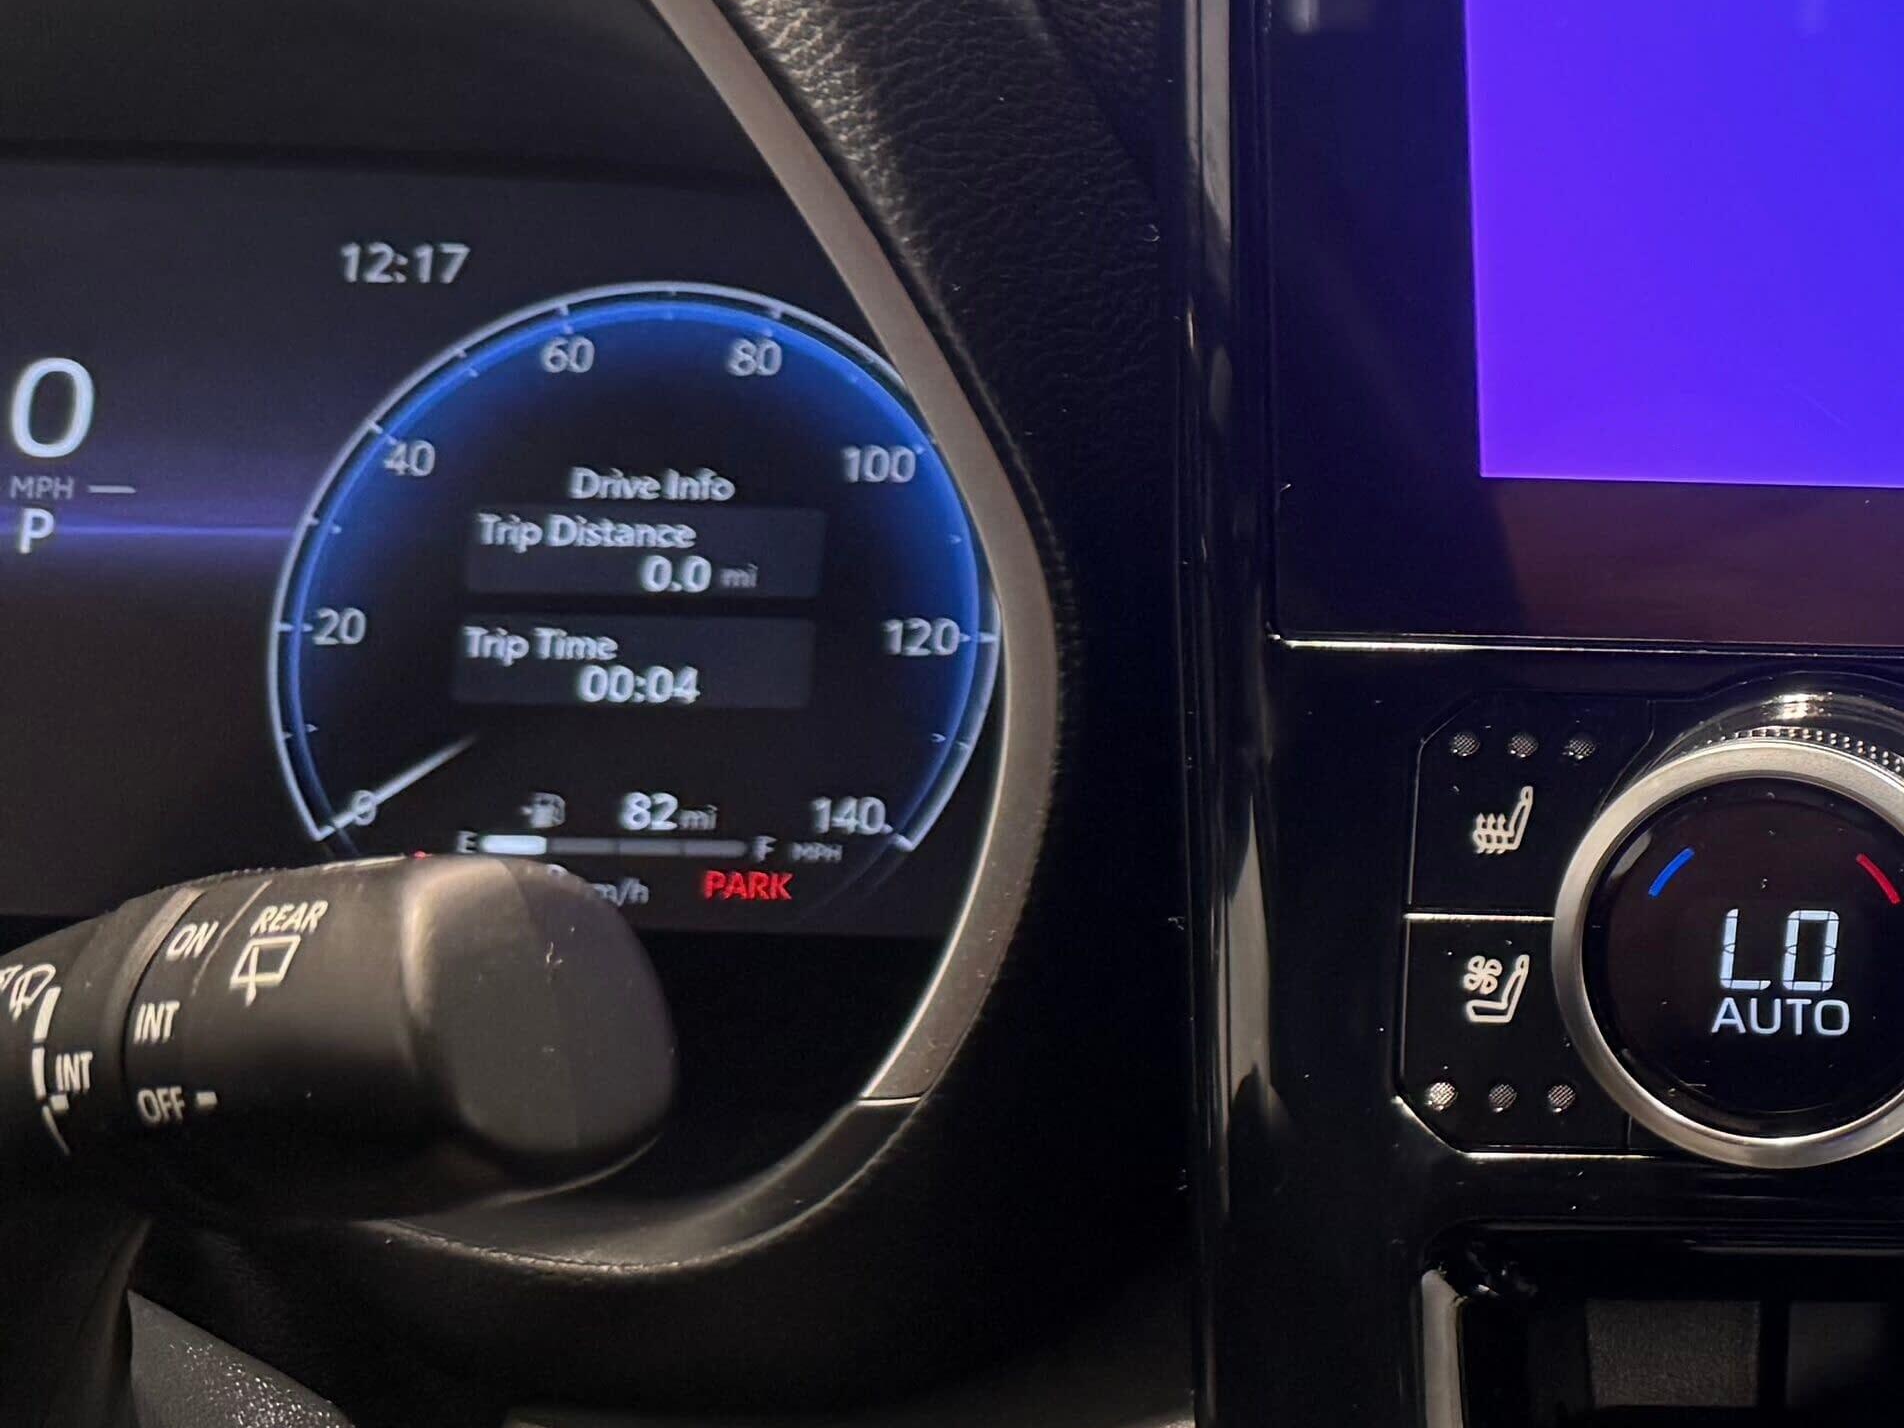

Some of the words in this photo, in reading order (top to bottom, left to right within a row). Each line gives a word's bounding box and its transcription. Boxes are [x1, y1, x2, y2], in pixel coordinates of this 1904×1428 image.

[340, 242, 470, 284] 12:17
[540, 337, 595, 373] 60
[727, 338, 783, 376] 80
[11, 357, 94, 458] 0
[385, 439, 436, 477] 40
[842, 445, 916, 483] 100
[10, 476, 74, 501] MPH
[569, 467, 660, 500] Drive
[662, 468, 735, 501] Info
[19, 508, 54, 554] P
[477, 513, 542, 552] Trip
[545, 515, 696, 548] Distance
[639, 555, 711, 592] 0.0
[721, 565, 758, 587] mi
[312, 607, 367, 645] 20
[883, 618, 960, 656] 120
[463, 626, 529, 666] Trip
[532, 628, 618, 661] Time
[578, 665, 700, 703] 00:04
[620, 792, 677, 831] 82
[680, 804, 717, 830] mi
[811, 796, 886, 835] 140
[456, 830, 478, 853] E
[752, 835, 777, 861] F
[704, 870, 793, 901] PARK
[250, 900, 328, 934] REAR
[165, 920, 218, 961] ON
[134, 1001, 180, 1044] INT
[1711, 997, 1850, 1036] AUTO
[55, 1051, 93, 1092] INT
[137, 1086, 185, 1125] OFF
